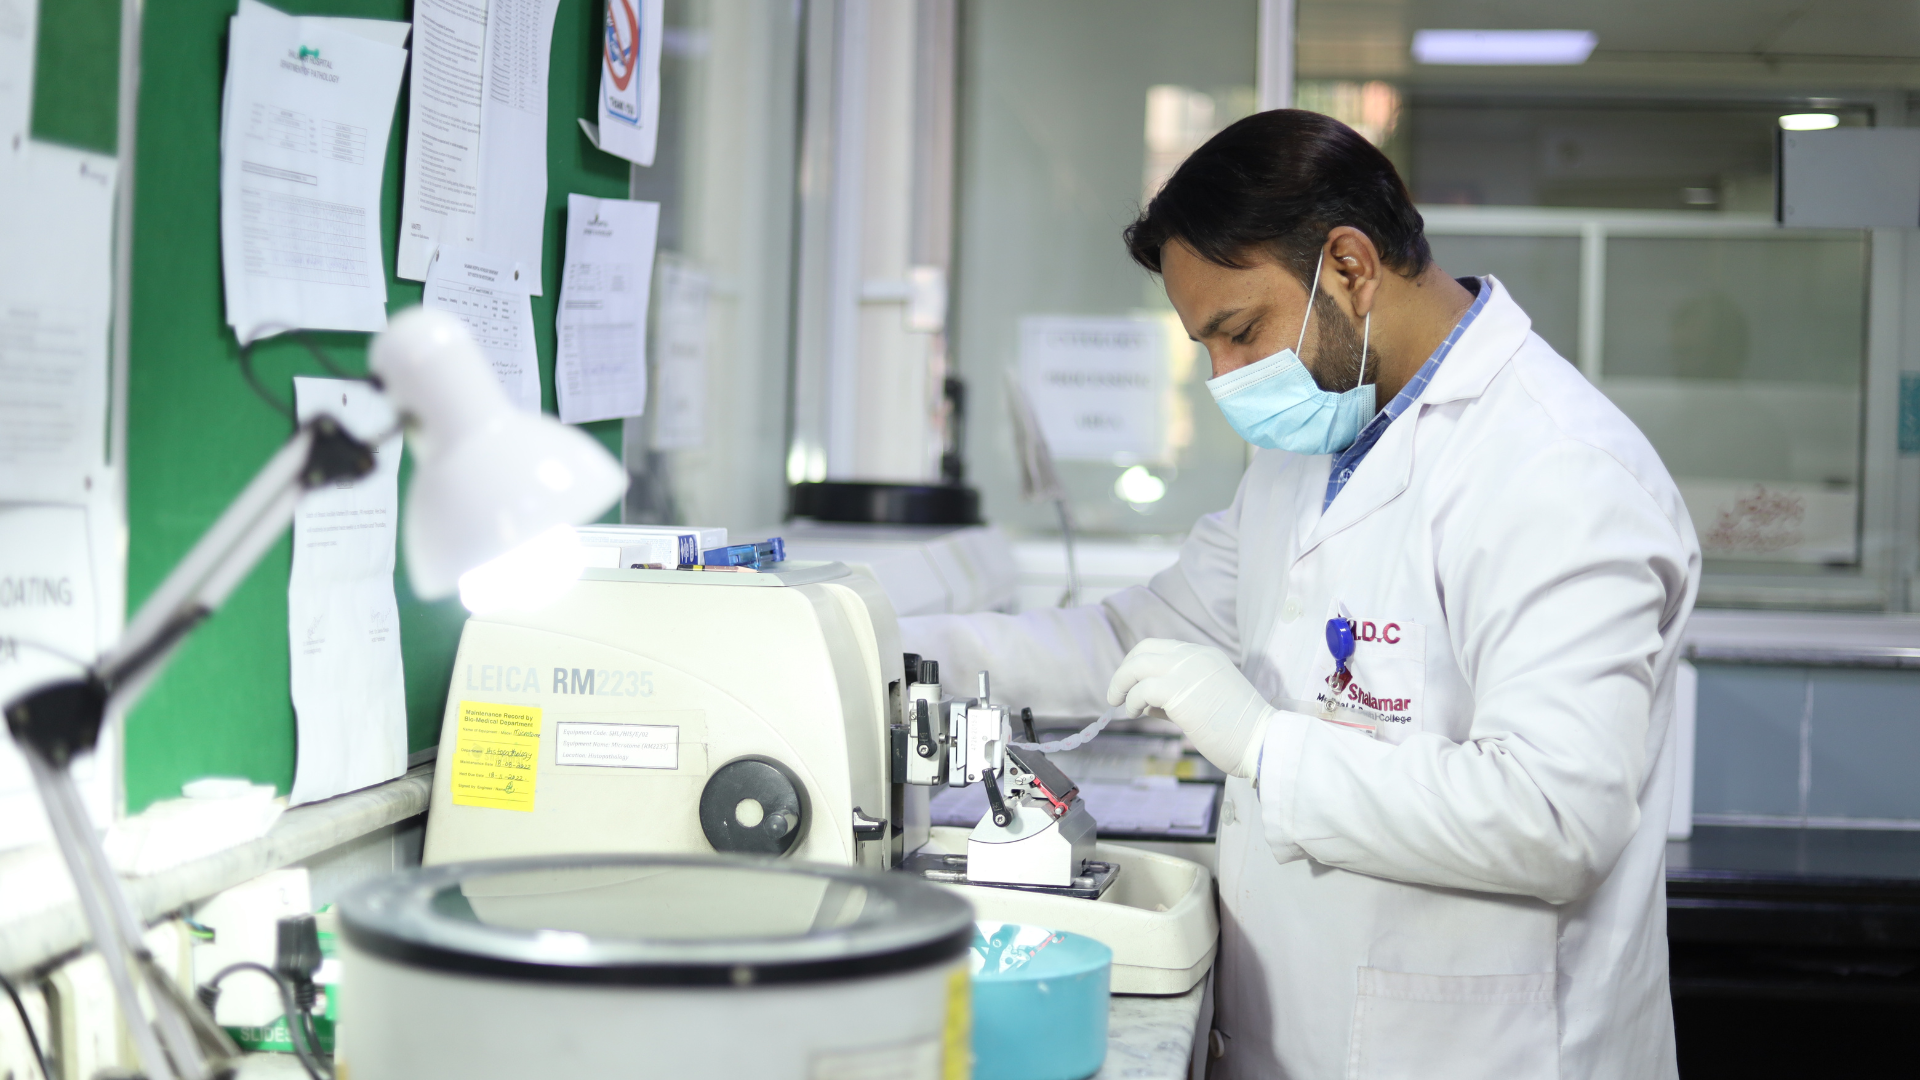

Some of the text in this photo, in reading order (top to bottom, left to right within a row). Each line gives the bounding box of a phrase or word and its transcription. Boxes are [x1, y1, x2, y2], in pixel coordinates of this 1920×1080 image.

[310, 69, 340, 83] PATHOLOGY
[466, 664, 655, 697] LEICA RM2235
[1348, 683, 1412, 711] Shalamar
[465, 709, 502, 718] Maintenance
[503, 712, 524, 720] Record
[1379, 713, 1412, 724] College
[464, 716, 534, 728] Bio-Medical Department
